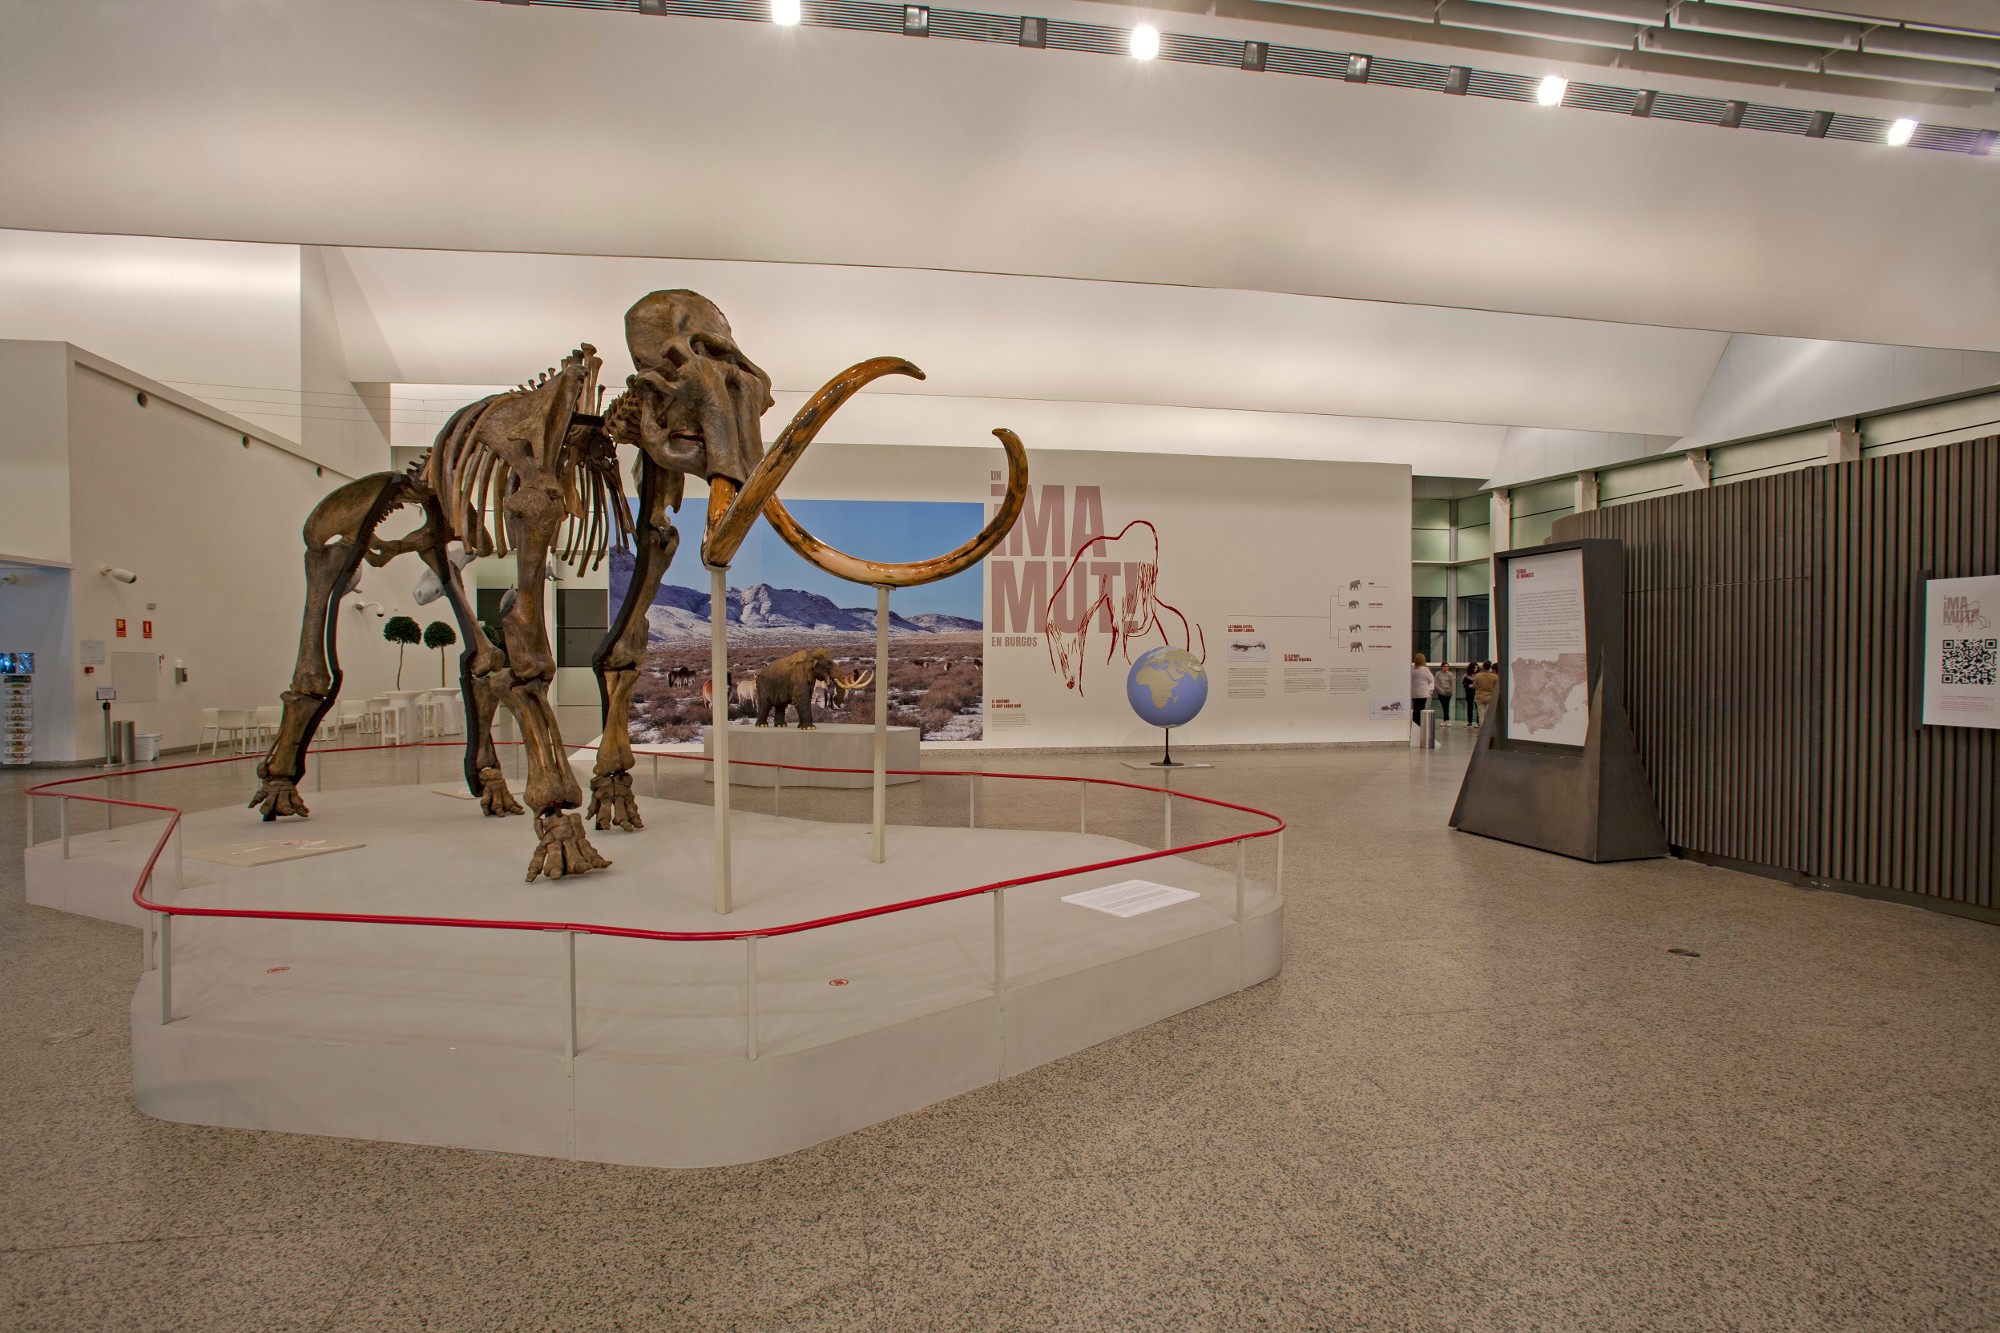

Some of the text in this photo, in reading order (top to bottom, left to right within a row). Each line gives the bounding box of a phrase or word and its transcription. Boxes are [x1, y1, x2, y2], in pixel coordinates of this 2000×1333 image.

[991, 470, 1001, 481] UN
[992, 637, 1038, 647] EN BURGOS
